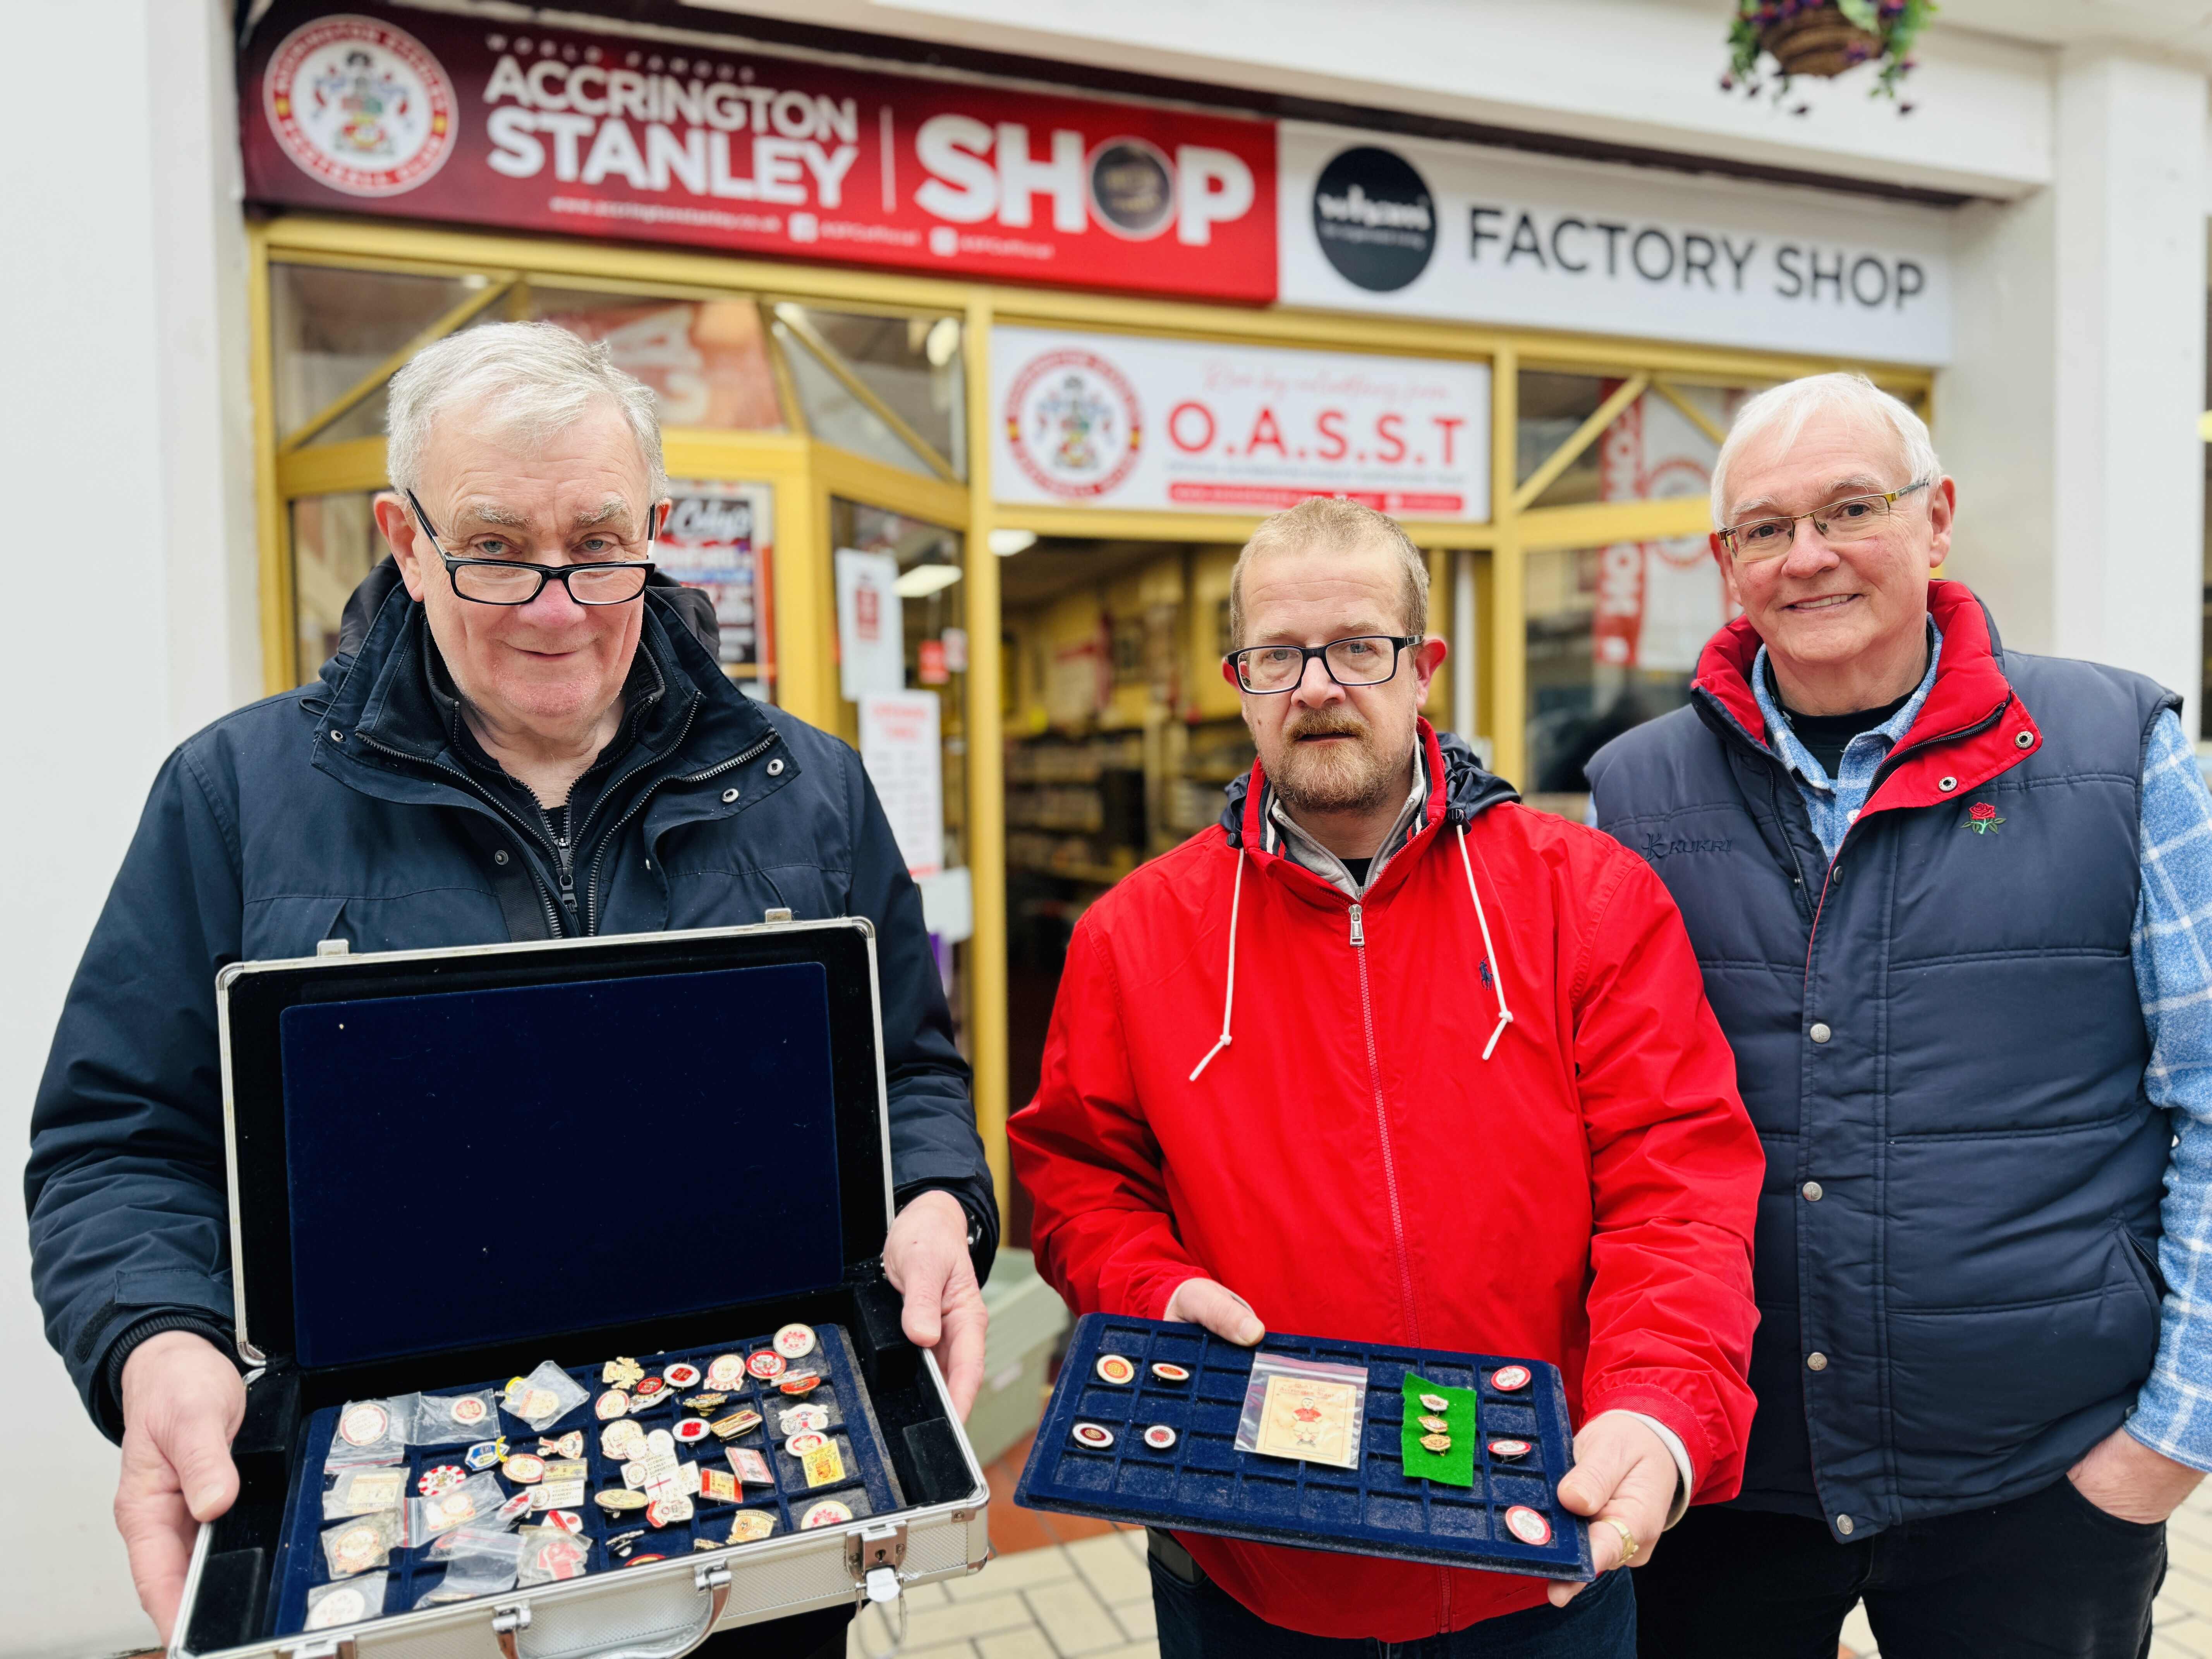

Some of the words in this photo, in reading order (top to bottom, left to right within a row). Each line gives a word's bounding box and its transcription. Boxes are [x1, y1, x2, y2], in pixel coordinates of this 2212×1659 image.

[483, 55, 857, 143] ACCRINGTON
[487, 106, 858, 210] STANLEY
[914, 113, 1255, 246] SHOP
[1468, 205, 1756, 293] FACTORY
[1776, 245, 1925, 311] SHOP
[1166, 400, 1467, 468] O.A.S.S.T
[1669, 839, 1733, 855] KUKRI
[646, 1453, 664, 1462] OFFICIAL
[647, 1454, 674, 1467] ACCRINGTON
[648, 1462, 666, 1471] STANLEY
[650, 1463, 676, 1475] SUPPORTERS
